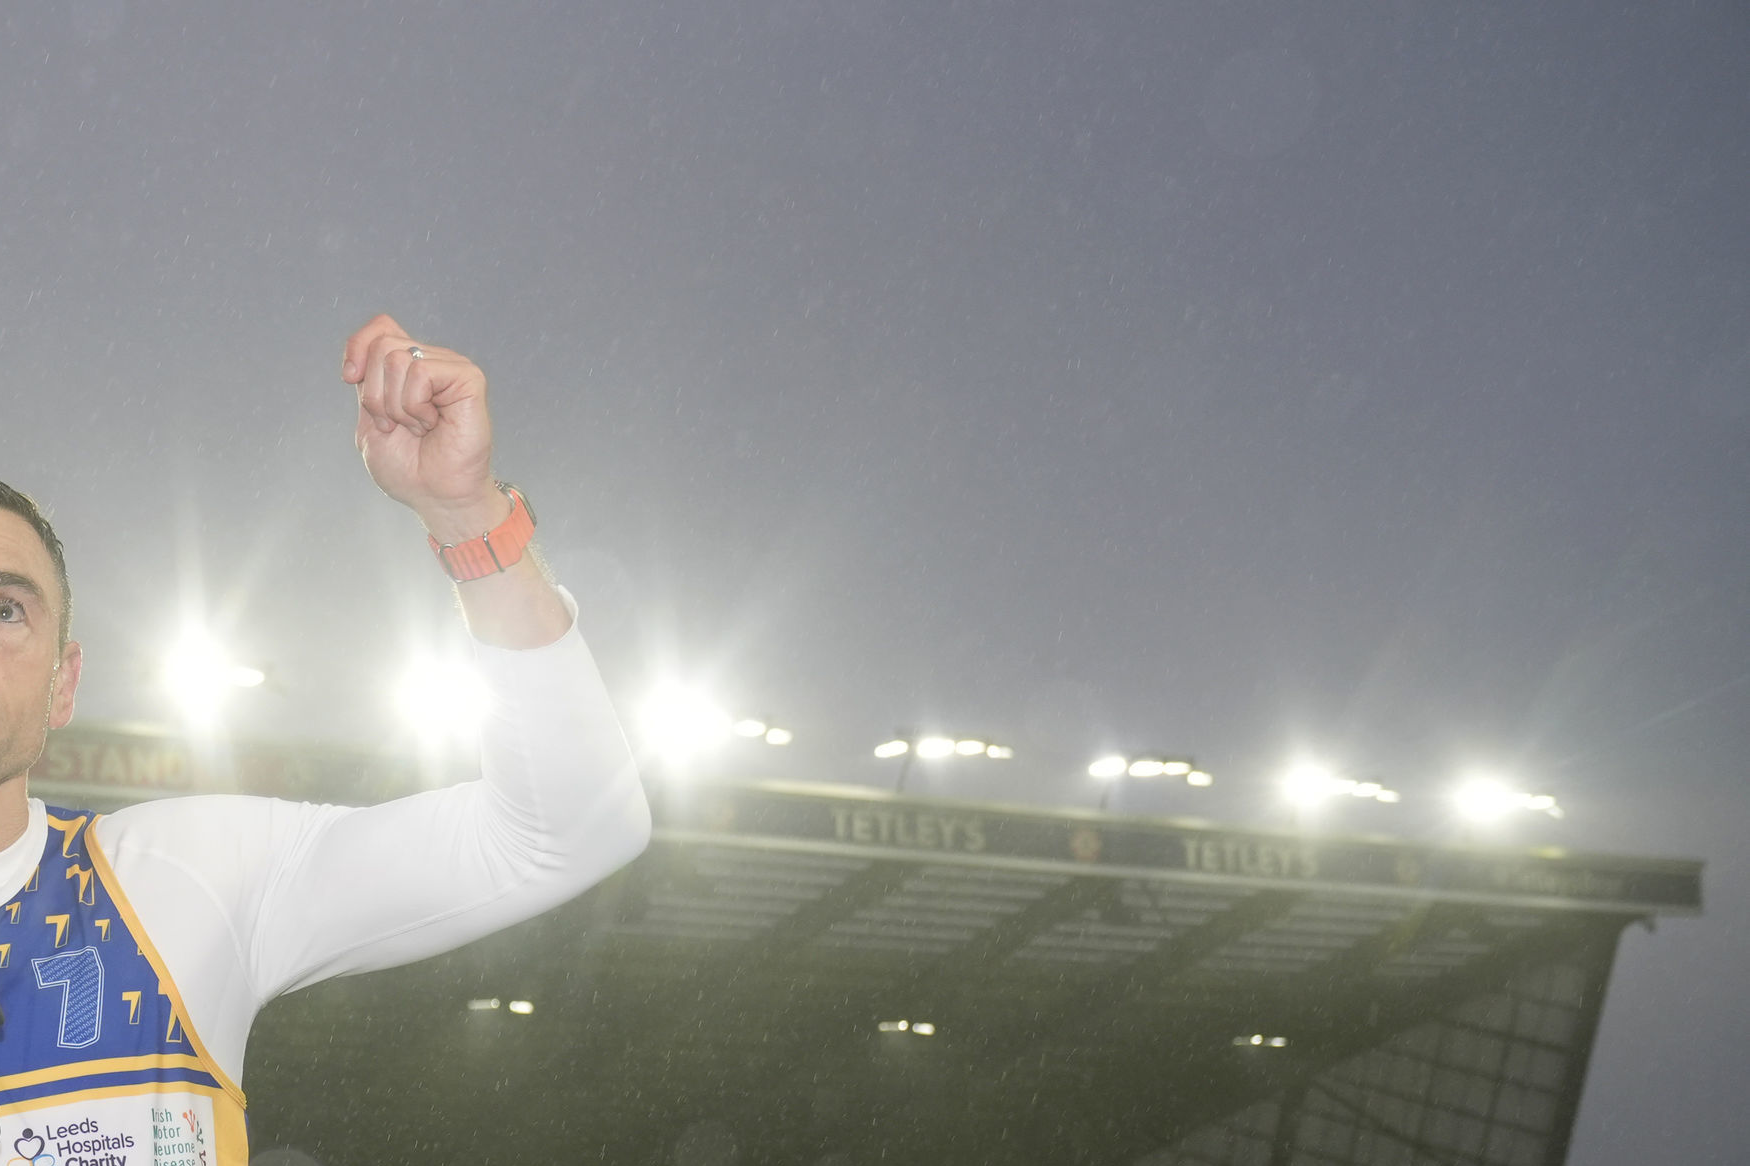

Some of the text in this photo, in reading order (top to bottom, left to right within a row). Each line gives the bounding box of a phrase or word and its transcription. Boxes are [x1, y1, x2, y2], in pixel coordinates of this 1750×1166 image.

[49, 742, 185, 787] STAND
[828, 806, 987, 851] TETLEY'S
[151, 1107, 173, 1123] Irish
[46, 1117, 99, 1141] Leeds
[153, 1125, 182, 1140] Motor
[56, 1133, 135, 1158] Hospitals
[153, 1142, 196, 1157] Neurone
